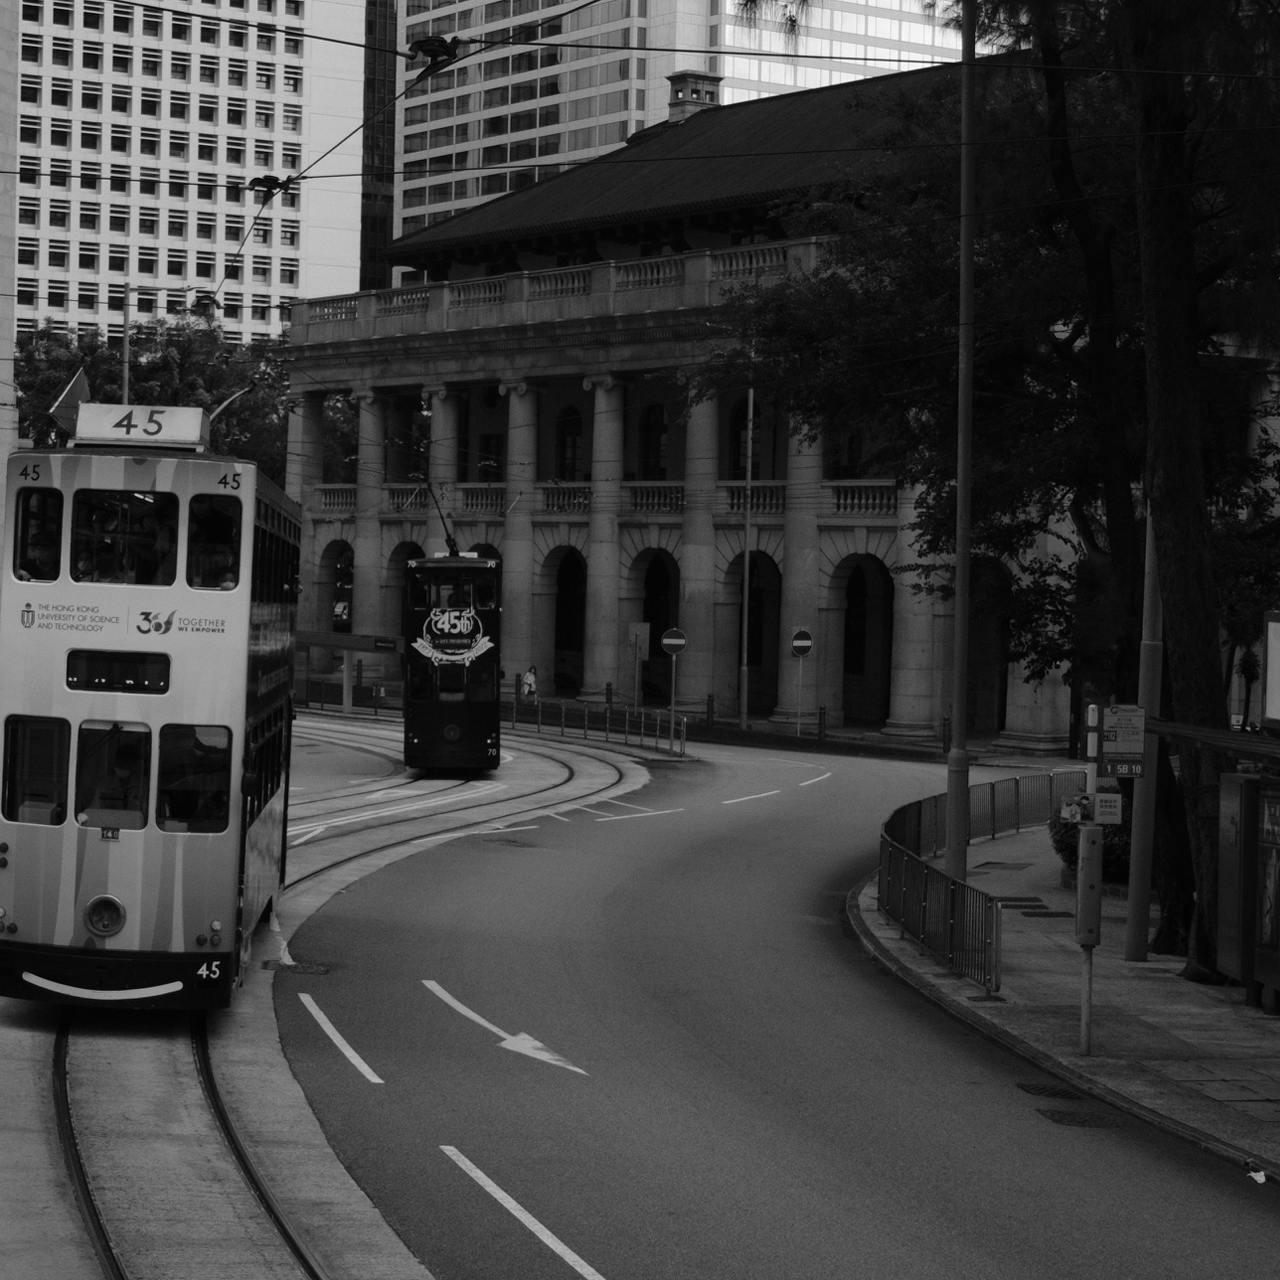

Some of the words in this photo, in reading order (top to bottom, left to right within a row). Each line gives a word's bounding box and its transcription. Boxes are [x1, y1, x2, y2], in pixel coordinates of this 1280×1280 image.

[112, 409, 167, 437] 45
[20, 464, 41, 481] 45
[217, 473, 241, 490] 45
[407, 560, 417, 569] 70
[487, 560, 496, 569] 70
[38, 603, 51, 612] THE
[51, 604, 76, 613] HONG
[76, 605, 100, 614] KONG
[37, 612, 77, 622] UNIVERSITY
[77, 614, 88, 622] OF
[89, 615, 120, 624] SCIENCE
[177, 617, 225, 628] TOGETHER
[37, 622, 53, 630] AND
[54, 622, 105, 632] TECHNOLOGY
[487, 748, 497, 756] 70
[1131, 764, 1142, 774] 10
[196, 961, 221, 980] 45
